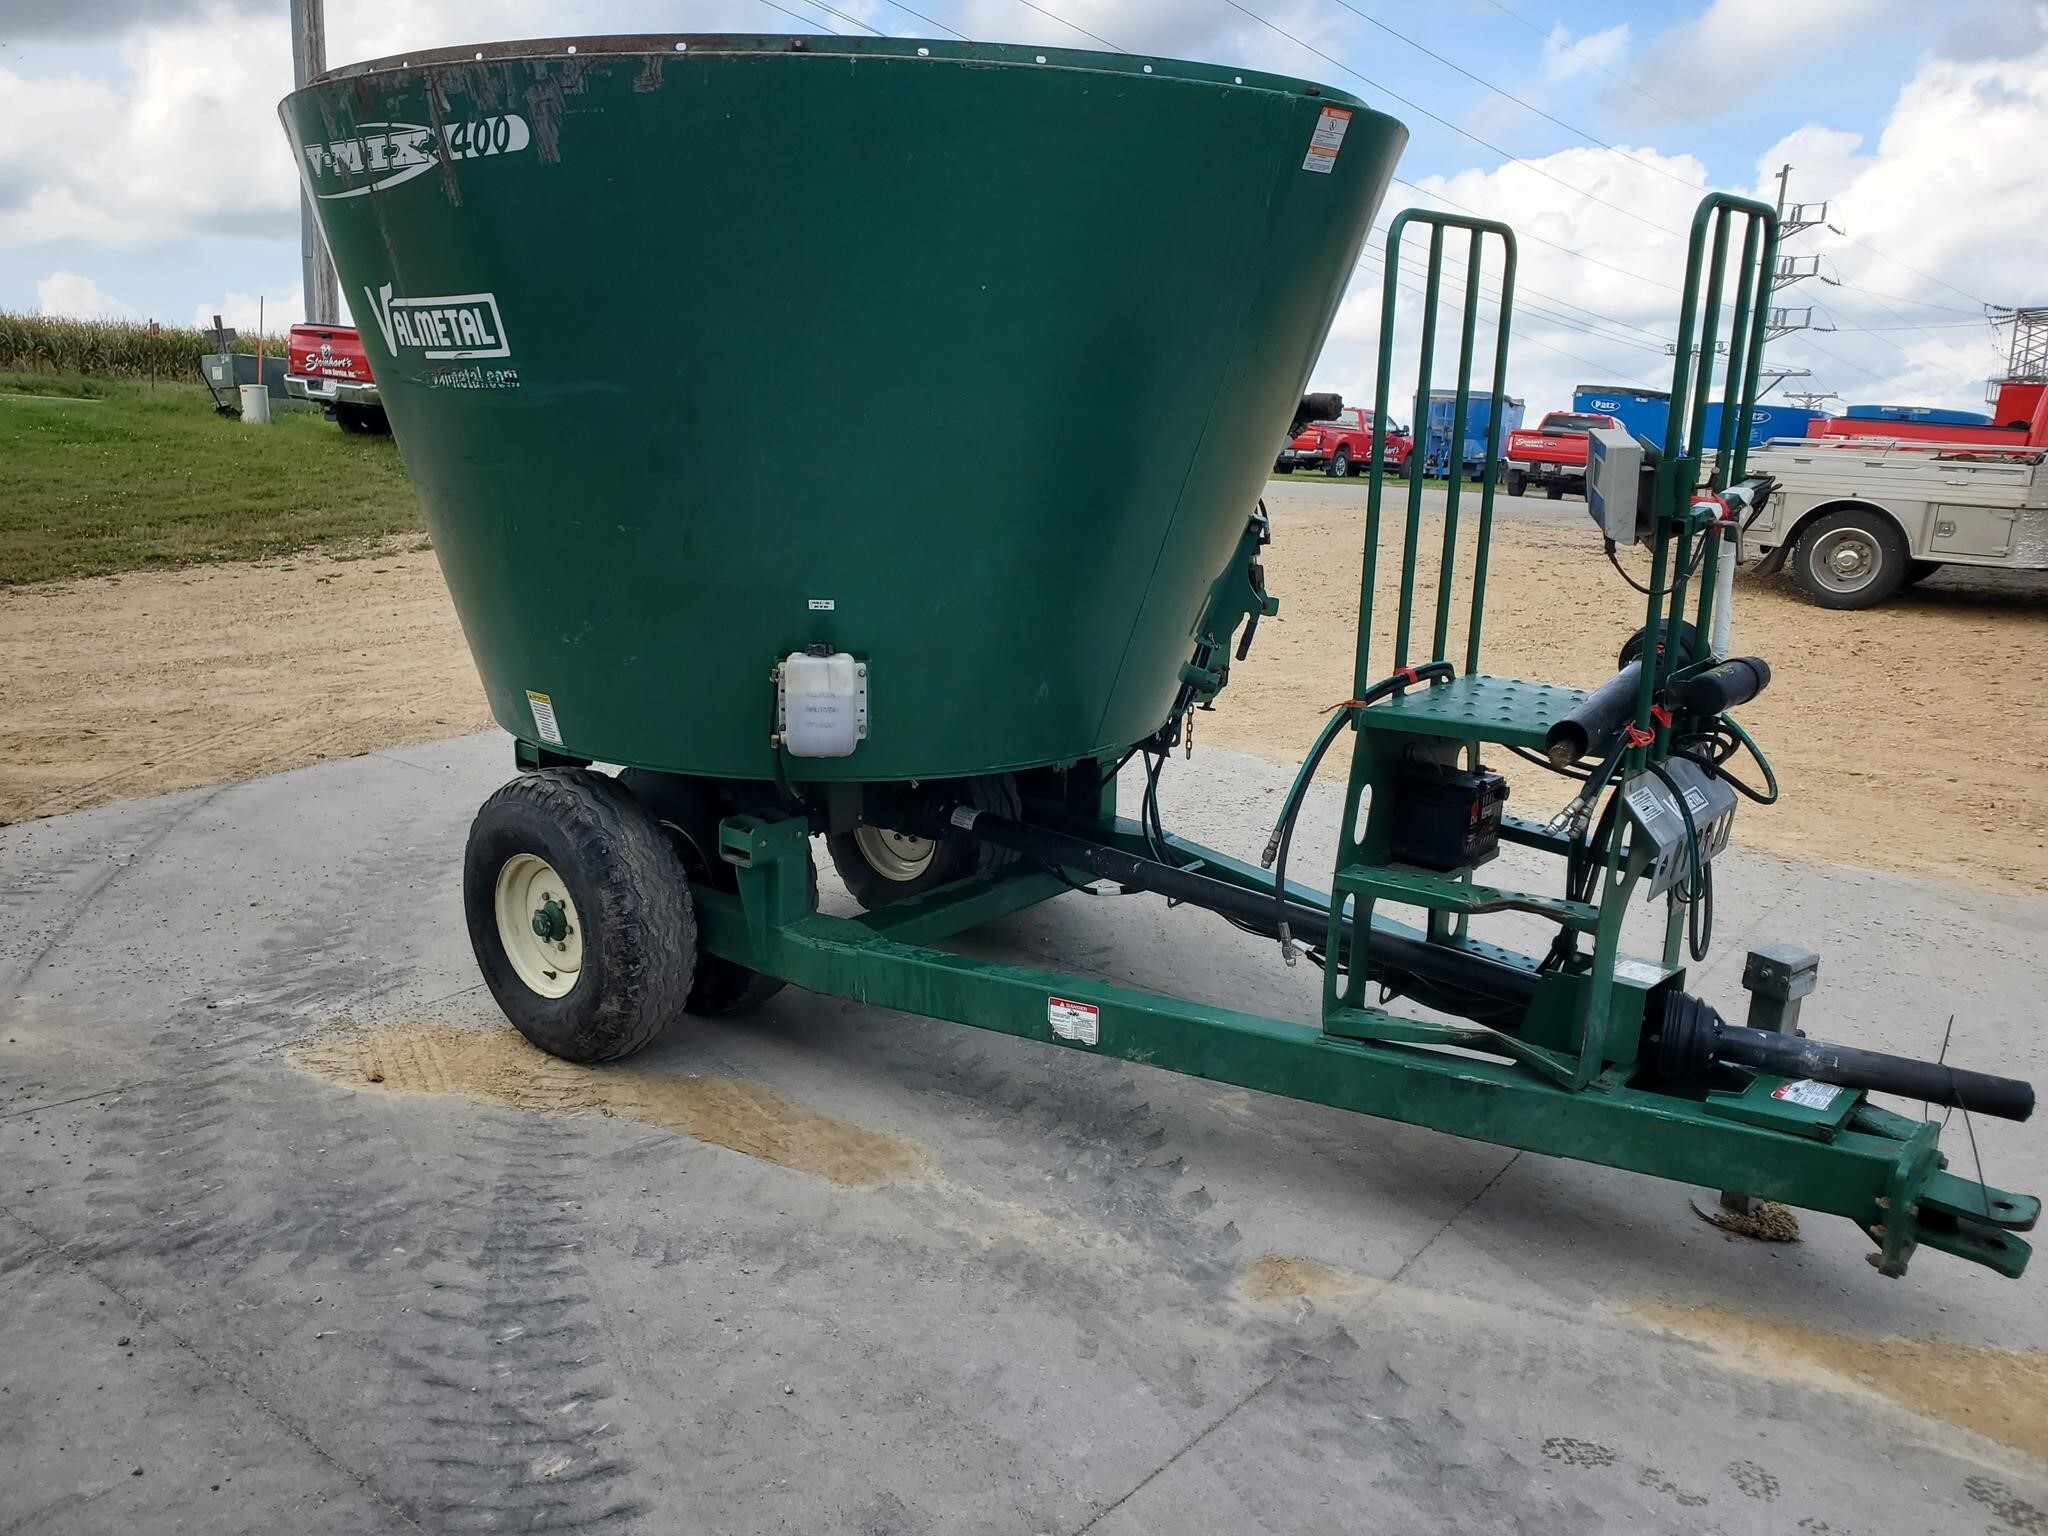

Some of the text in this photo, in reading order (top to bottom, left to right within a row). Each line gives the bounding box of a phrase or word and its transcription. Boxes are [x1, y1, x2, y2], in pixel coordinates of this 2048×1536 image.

[450, 115, 510, 158] 400
[363, 281, 497, 358] VALMETAL
[1066, 1003, 1088, 1011] DANGER
